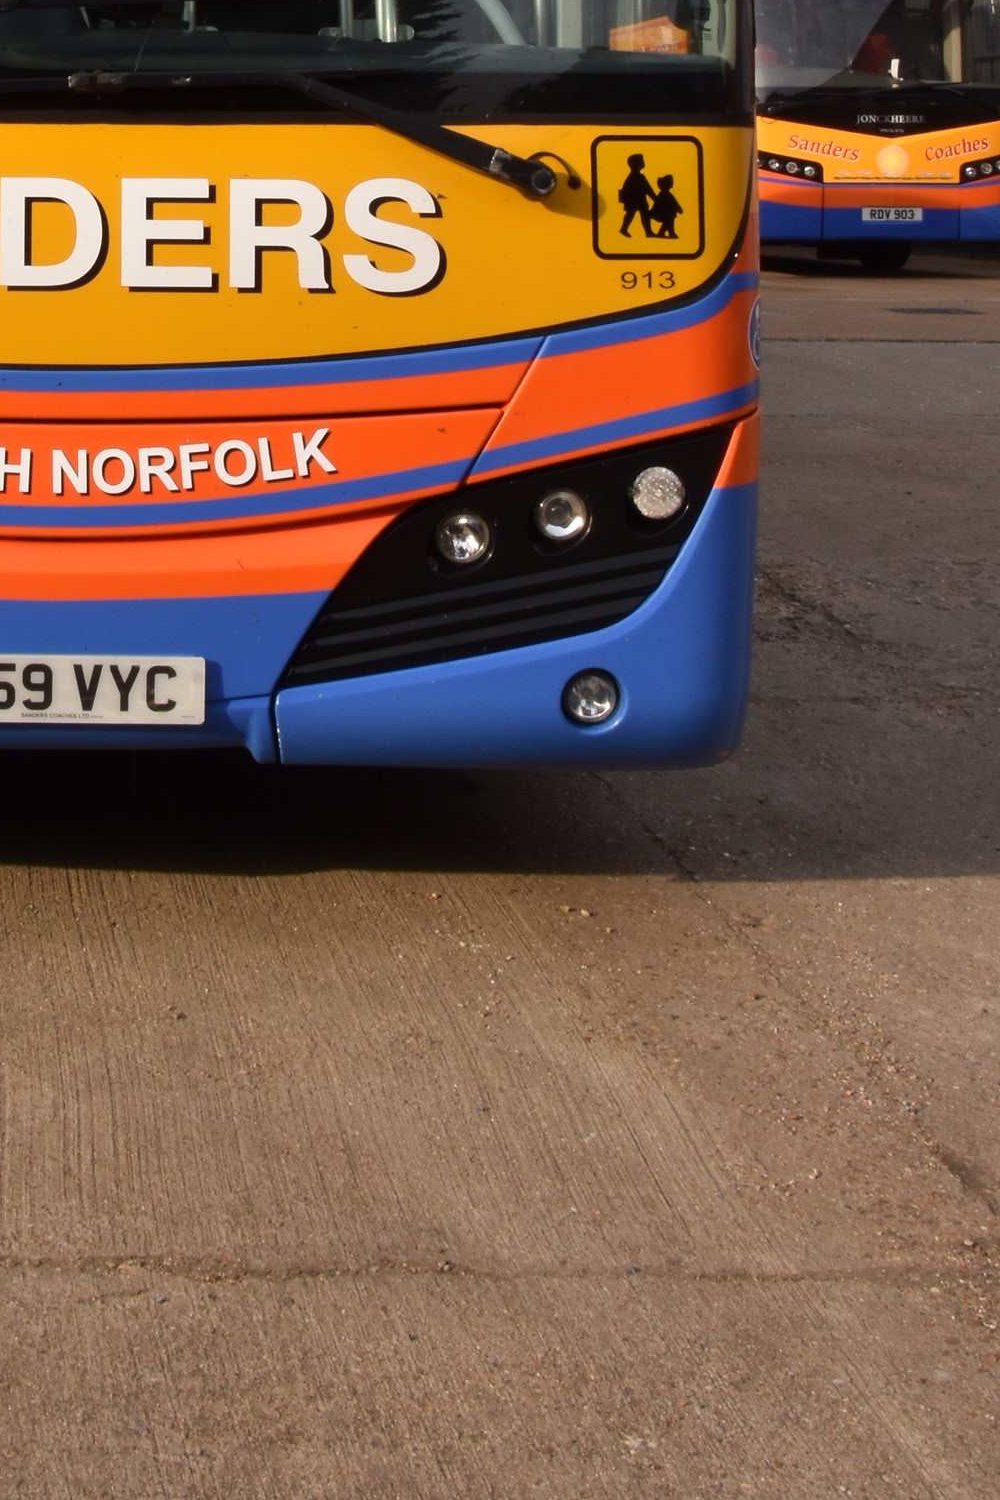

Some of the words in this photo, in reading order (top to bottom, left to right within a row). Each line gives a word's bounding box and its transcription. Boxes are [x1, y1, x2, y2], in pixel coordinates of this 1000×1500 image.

[856, 114, 925, 124] JONCKHEERE
[788, 134, 859, 161] Sanders
[925, 137, 989, 162] Coaches
[870, 209, 891, 219] RDV
[894, 209, 915, 220] 903
[621, 271, 675, 289] 913
[52, 427, 337, 496] NORFOLK
[73, 664, 177, 712] VYC
